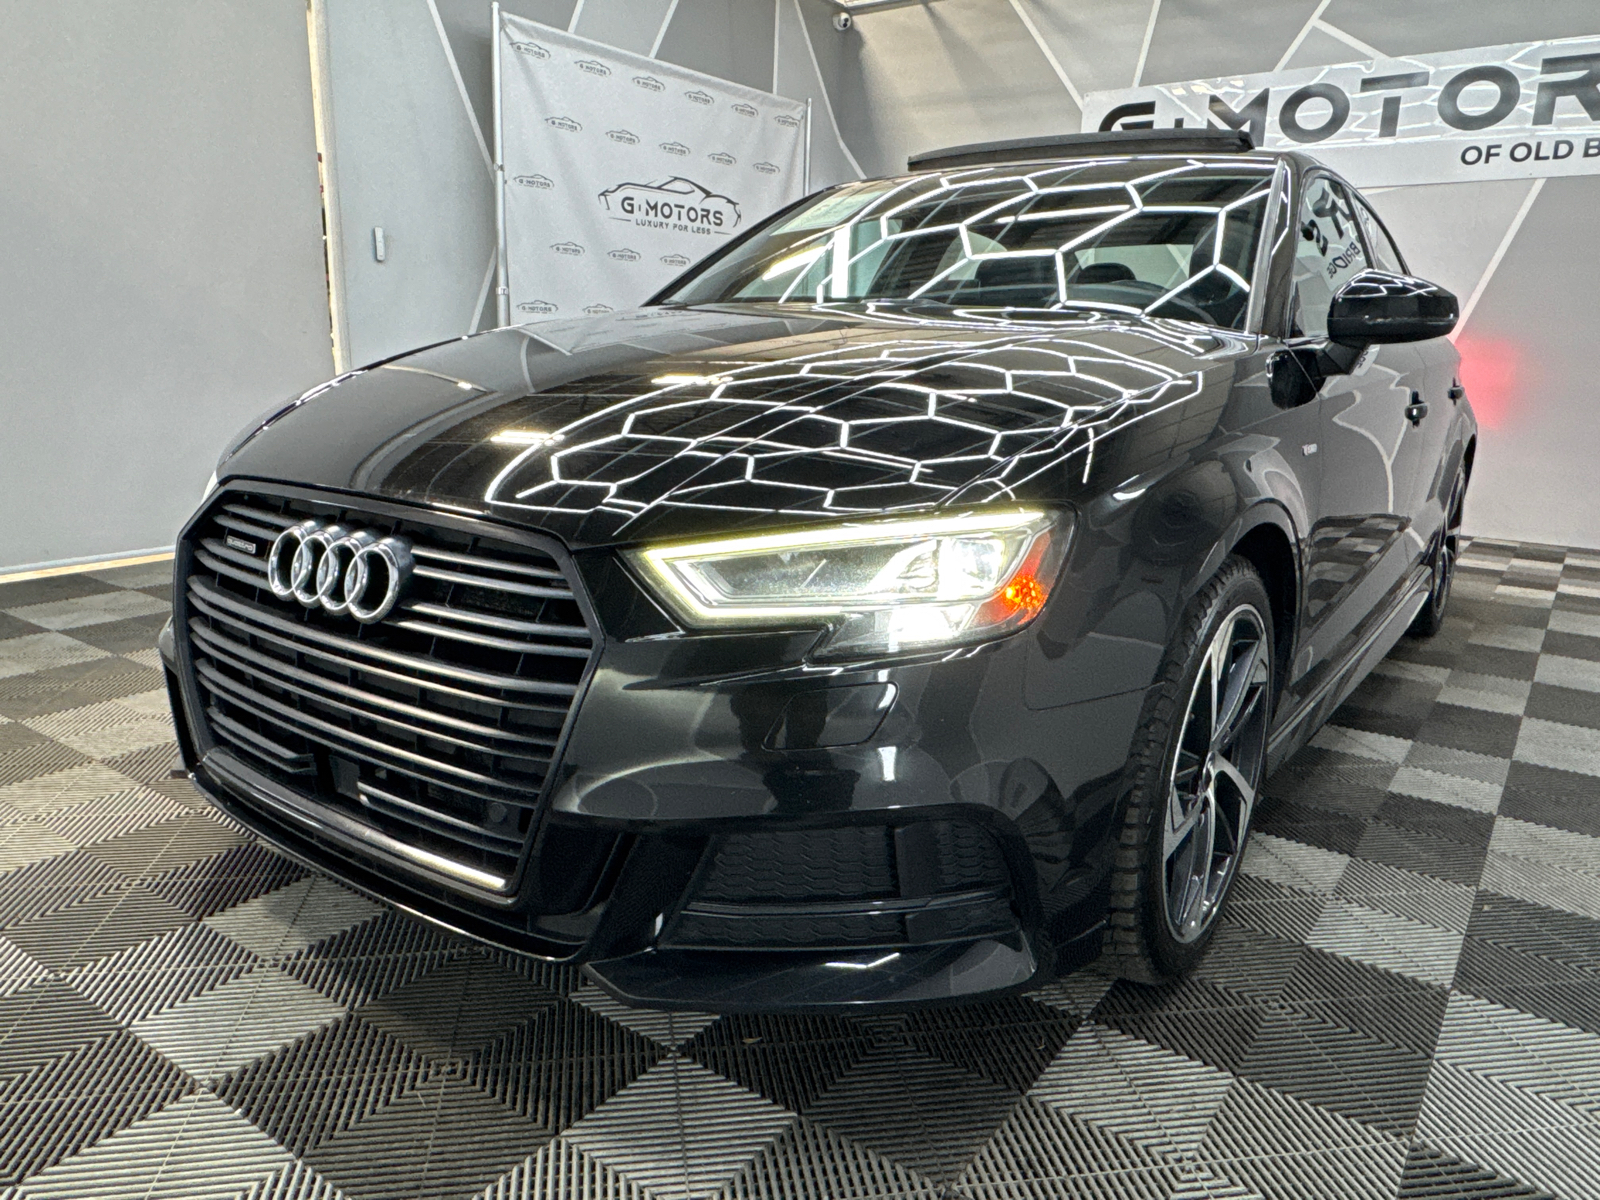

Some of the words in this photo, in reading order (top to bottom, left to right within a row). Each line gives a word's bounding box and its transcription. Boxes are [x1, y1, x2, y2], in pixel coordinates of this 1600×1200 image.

[1460, 144, 1503, 166] OF
[1509, 140, 1574, 162] OLD
[635, 218, 670, 230] LUXURY
[672, 223, 689, 233] FOR
[691, 227, 712, 235] LESS
